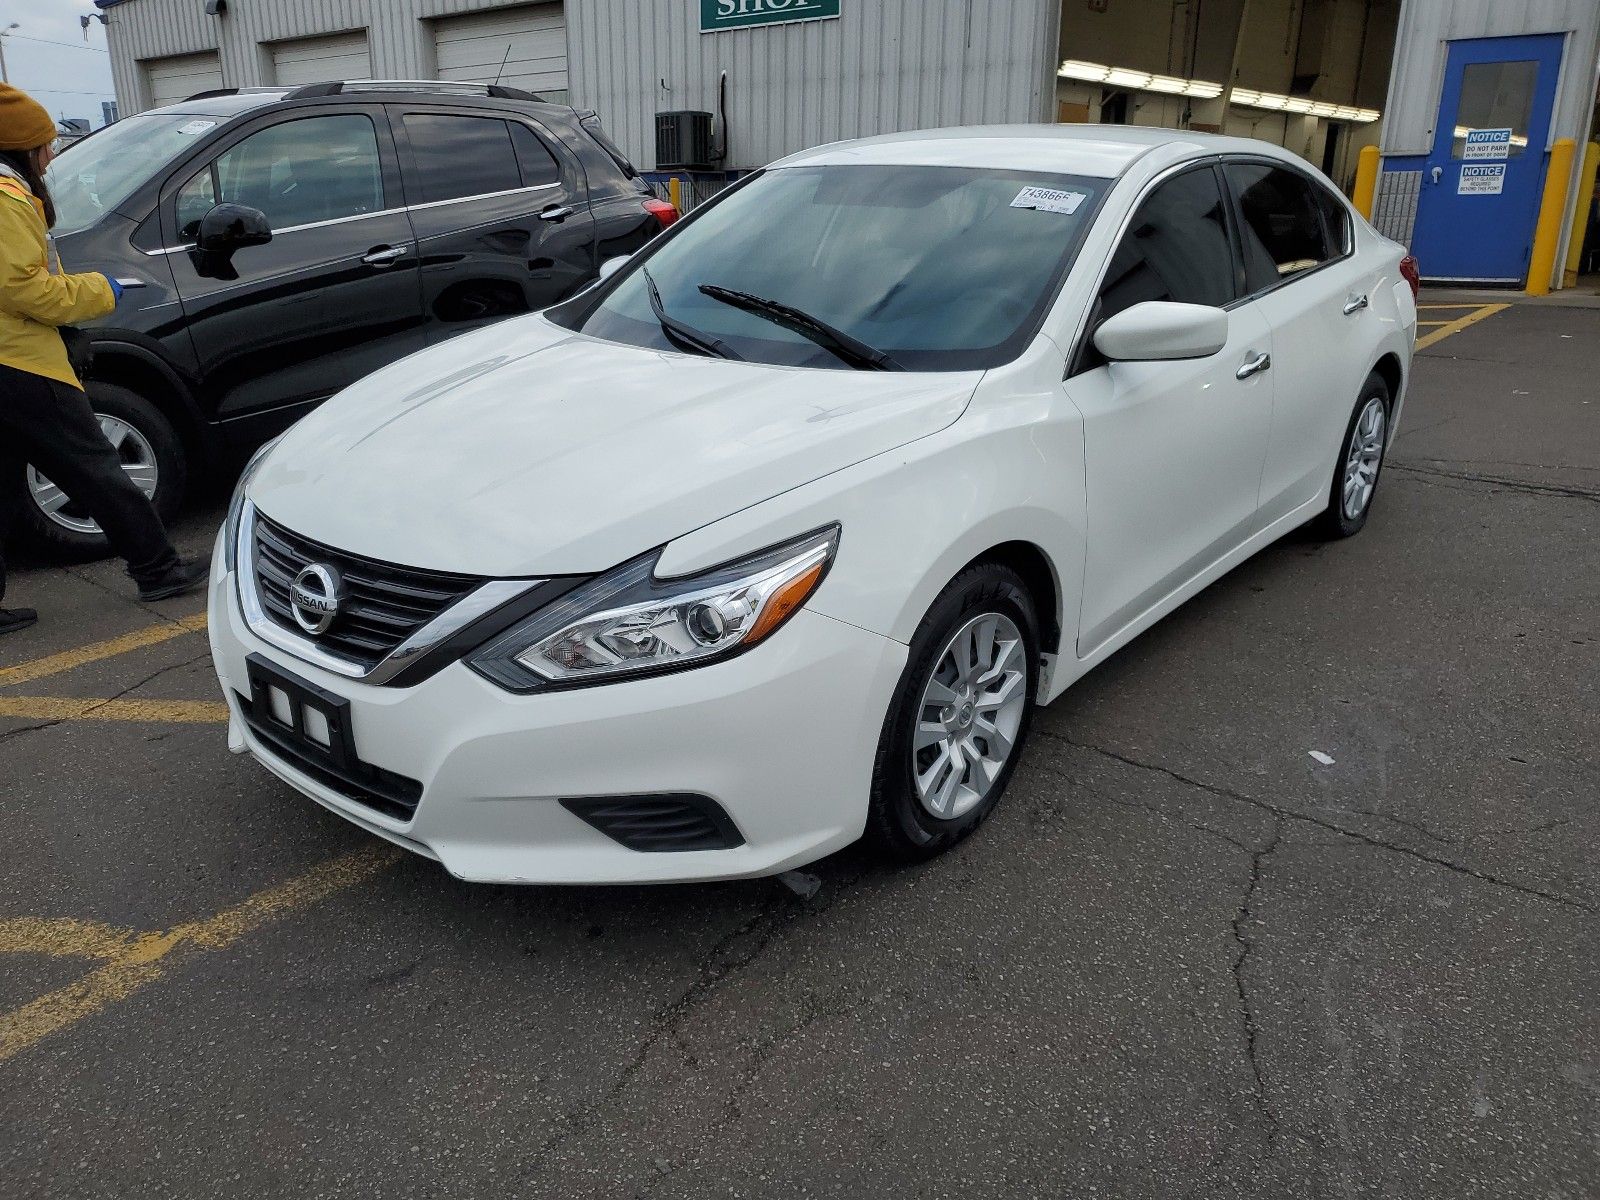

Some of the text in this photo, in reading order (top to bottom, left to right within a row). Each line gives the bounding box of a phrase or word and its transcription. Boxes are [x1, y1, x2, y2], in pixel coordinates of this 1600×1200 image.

[718, 0, 808, 15] SH
[1469, 132, 1508, 142] NOTICE
[1464, 167, 1501, 176] NOTICE
[291, 587, 328, 611] NISSAN
